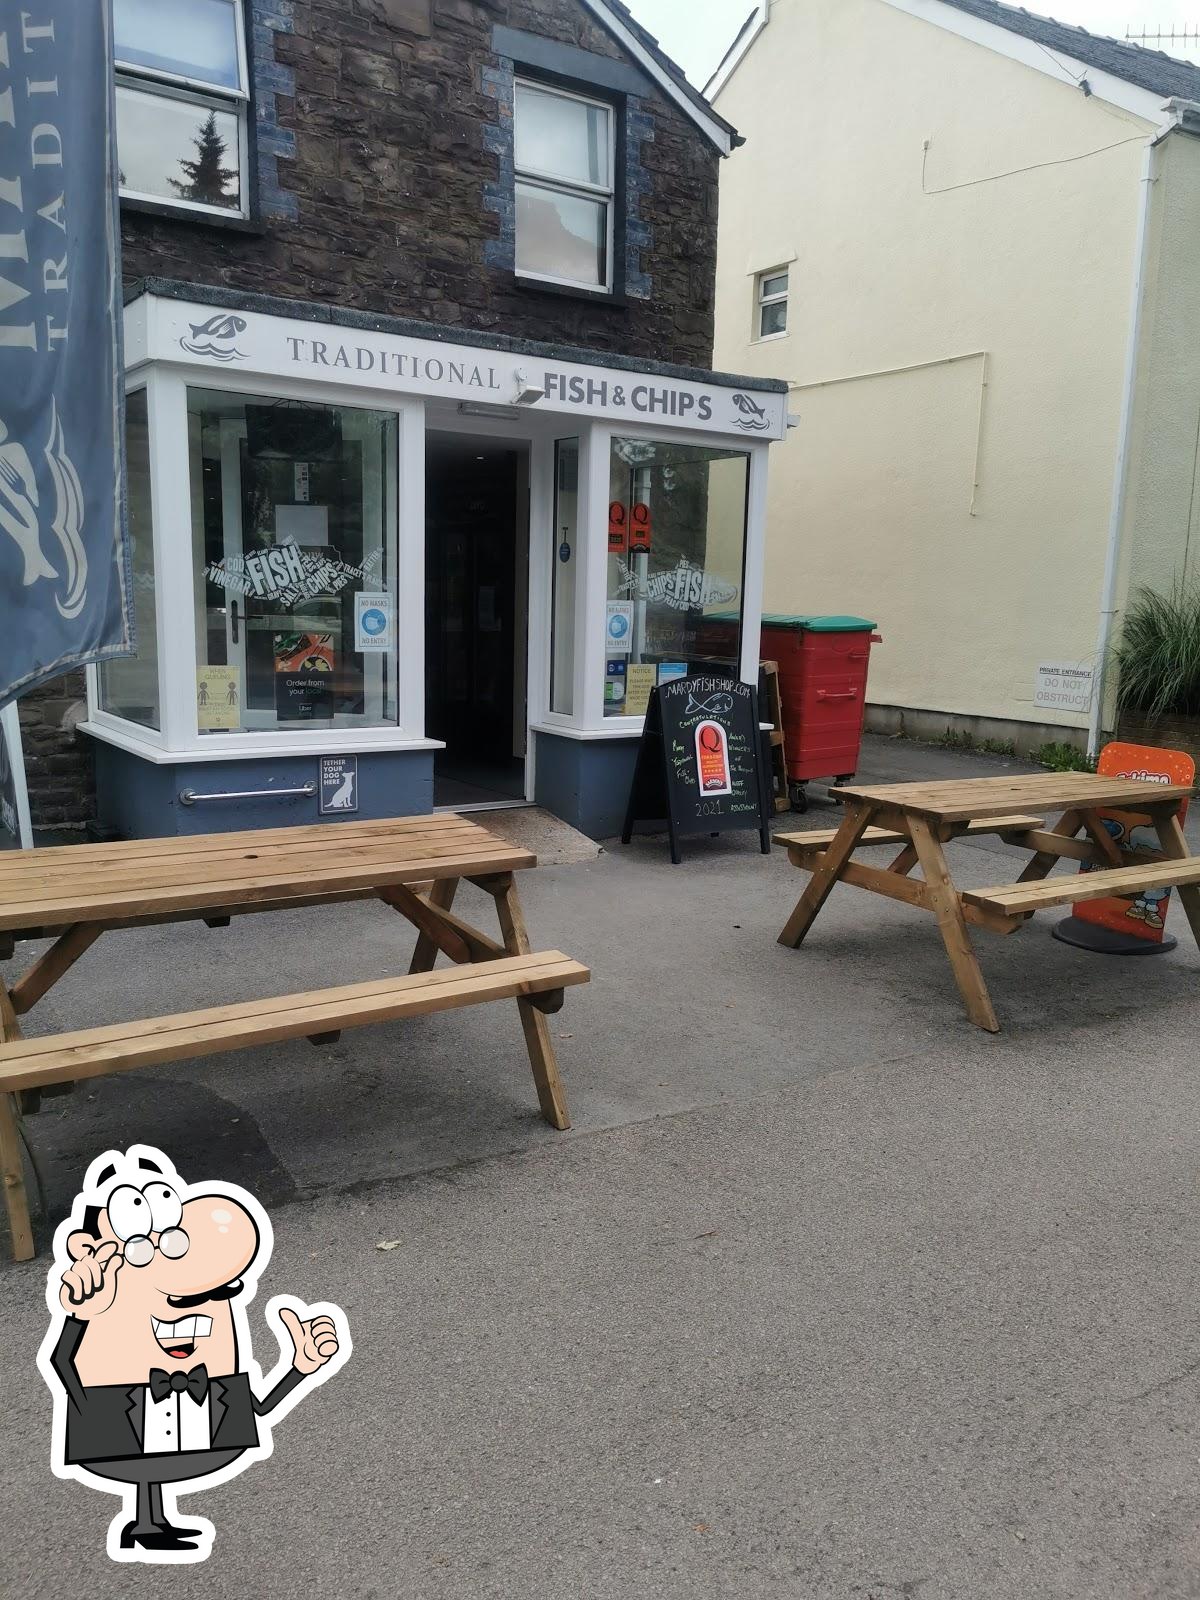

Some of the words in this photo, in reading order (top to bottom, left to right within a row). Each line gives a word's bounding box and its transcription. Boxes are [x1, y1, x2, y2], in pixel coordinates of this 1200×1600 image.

[286, 337, 501, 389] TRADITIONAL
[544, 372, 608, 407] FISH
[612, 385, 626, 406] &
[630, 385, 713, 421] CHIPS
[227, 557, 245, 573] COD
[246, 545, 306, 596] FISH
[306, 563, 339, 594] CHIPS
[209, 567, 252, 597] VINEGAR
[646, 572, 675, 598] CHIPS
[674, 568, 712, 604] FISH
[286, 679, 306, 687] Order
[308, 679, 325, 687] from
[1044, 678, 1059, 687] DO
[1062, 679, 1082, 690] NOT
[1036, 691, 1089, 705] OBSTRUCT
[701, 725, 720, 753] Q
[696, 800, 725, 817] 2021
